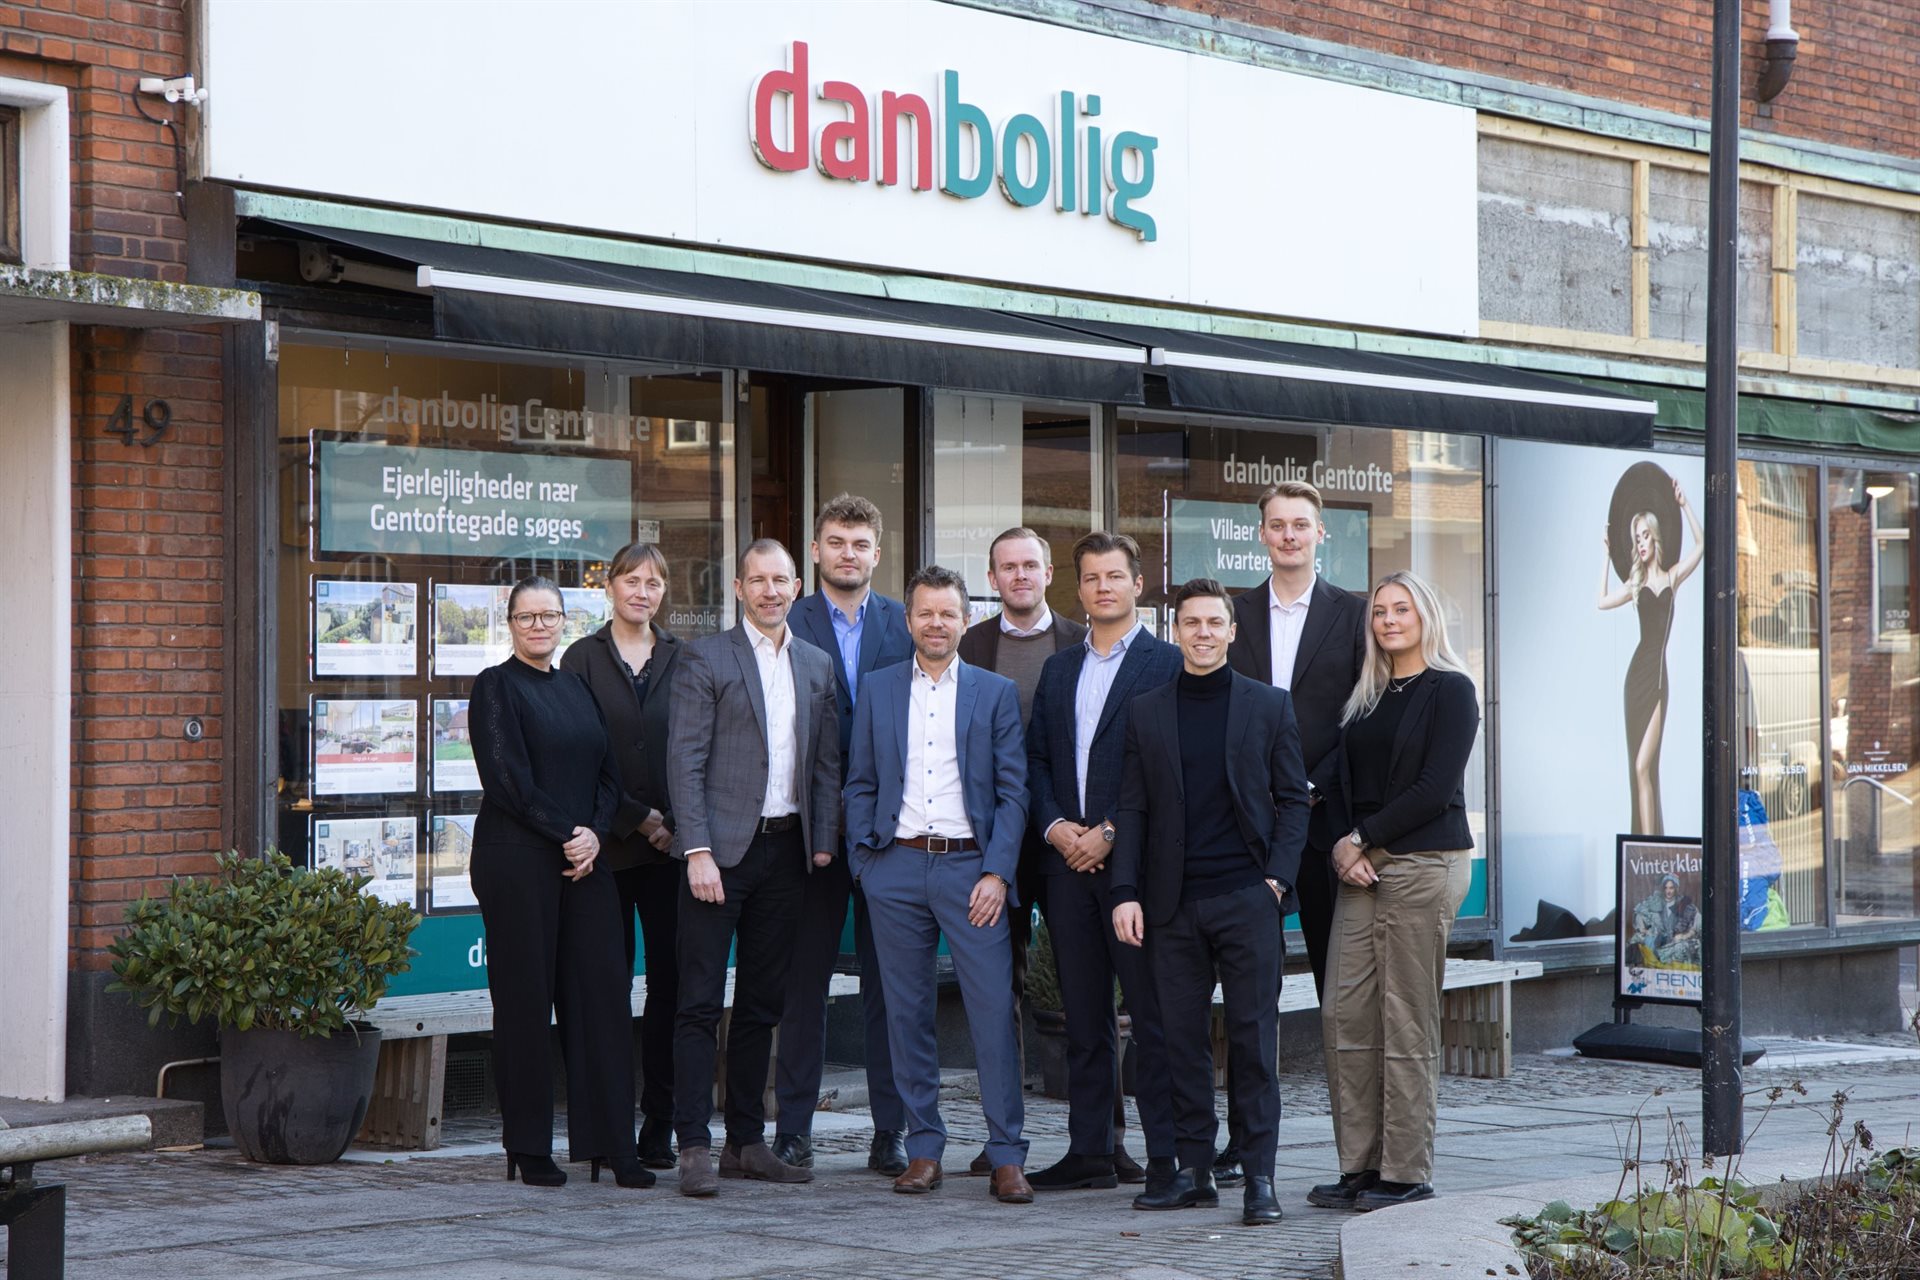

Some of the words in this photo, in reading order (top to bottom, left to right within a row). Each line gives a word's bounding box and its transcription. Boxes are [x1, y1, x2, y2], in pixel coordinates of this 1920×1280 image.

[749, 40, 1159, 242] danbolig
[103, 394, 171, 448] 49
[382, 386, 516, 441] danbolig
[525, 398, 650, 442] Gentofte
[382, 466, 533, 504] Ejerlejligheder
[539, 481, 578, 503] nær
[1312, 460, 1393, 493] Gentofte
[370, 504, 518, 541] Gentoftegade
[1210, 518, 1254, 541] Villaer
[1217, 548, 1274, 572] kvartere
[669, 610, 717, 627] danbolig
[1741, 766, 1758, 775] JAN
[1847, 763, 1863, 773] JAN
[1864, 762, 1908, 773] MIKKELSEN
